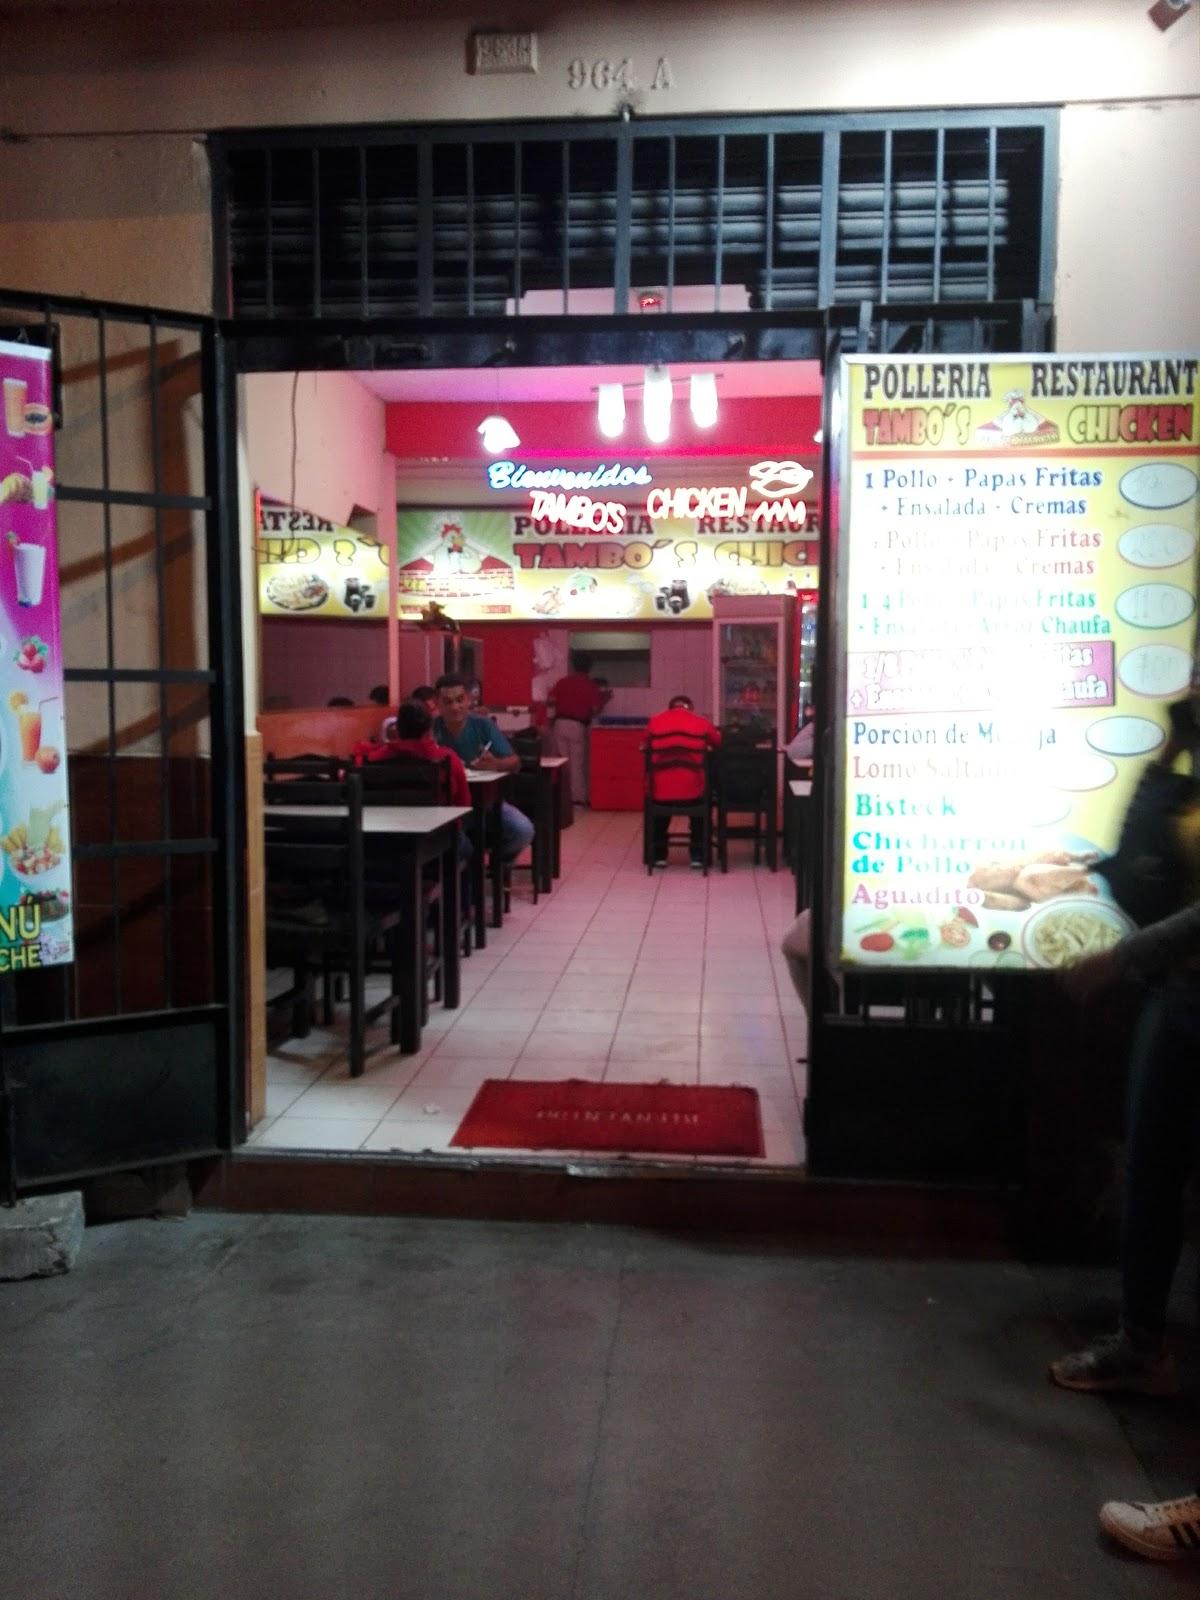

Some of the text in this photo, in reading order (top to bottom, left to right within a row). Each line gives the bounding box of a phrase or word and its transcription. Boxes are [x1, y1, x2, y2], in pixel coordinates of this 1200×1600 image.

[567, 56, 675, 91] 964 A
[864, 360, 1198, 399] POLLERIA RESTAURANT
[862, 402, 1194, 446] TAMBO'S CHICKEN
[865, 473, 873, 489] 1
[882, 468, 938, 489] Pollo
[964, 468, 1027, 492] Papas
[1035, 466, 1103, 487] Fritas
[646, 486, 748, 520] CHICKEN
[897, 497, 986, 516] Ensalada
[1011, 496, 1087, 515] Cremas
[1036, 527, 1102, 549] Fritas
[1036, 588, 1097, 609] Fritas
[1041, 613, 1112, 635] Chaufa
[853, 721, 937, 745] Porcion
[946, 723, 969, 744] de
[853, 755, 916, 779] Lomo
[855, 793, 957, 817] Bisteck
[852, 855, 971, 874] de Pollo
[851, 883, 981, 910] Aguadito
